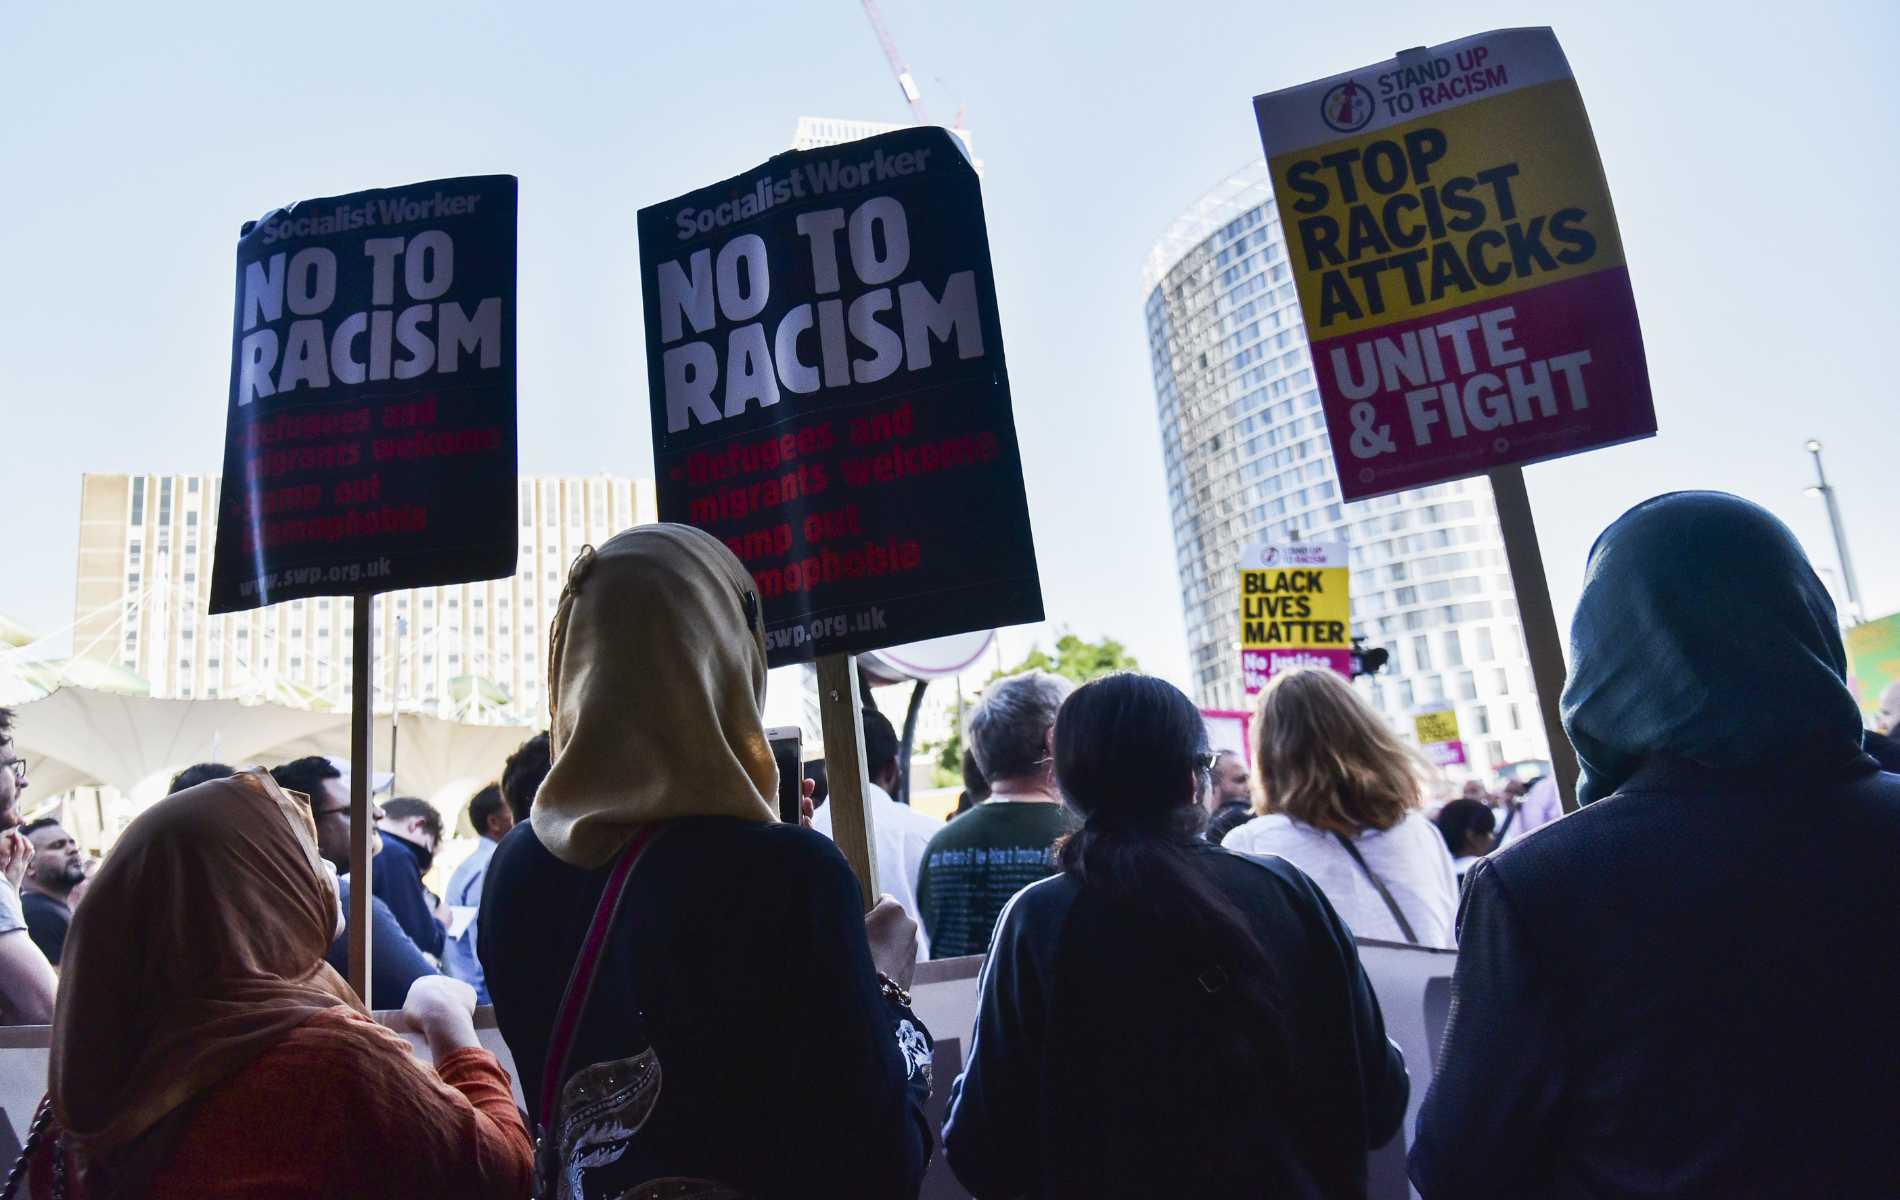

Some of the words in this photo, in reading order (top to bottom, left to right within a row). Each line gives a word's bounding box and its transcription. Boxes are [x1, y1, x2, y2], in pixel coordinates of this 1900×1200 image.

[1378, 57, 1450, 95] STAND
[1455, 46, 1488, 72] UP
[1382, 92, 1414, 117] TO
[1419, 64, 1508, 107] RACISM
[676, 170, 805, 240] Socialist
[804, 143, 931, 195] Worker
[1286, 127, 1447, 213] STOP
[1298, 163, 1519, 271] RACIST
[242, 246, 337, 332] NO
[364, 230, 454, 306] TO
[658, 233, 769, 344] NO
[796, 197, 911, 294] TO
[1319, 206, 1596, 327] ATTACKS
[237, 296, 502, 407] RACISM
[663, 270, 985, 434] RACISM
[1330, 306, 1526, 400] UNITE
[384, 398, 438, 427] and
[1349, 402, 1396, 459] &
[1404, 351, 1591, 446] FIGHT
[372, 427, 502, 462] welcome
[687, 419, 835, 486] Refugees
[849, 401, 914, 443] and
[690, 464, 828, 526] migrants
[843, 432, 1001, 486] welcome
[335, 472, 382, 503] out
[725, 523, 793, 560] amp
[803, 504, 862, 543] out
[754, 535, 921, 598] mophobia
[1244, 570, 1323, 594] BLACK
[1244, 595, 1311, 619] LIVES
[765, 606, 886, 651] swp.org.uk
[1244, 652, 1268, 672] No
[1245, 620, 1345, 643] MATTER
